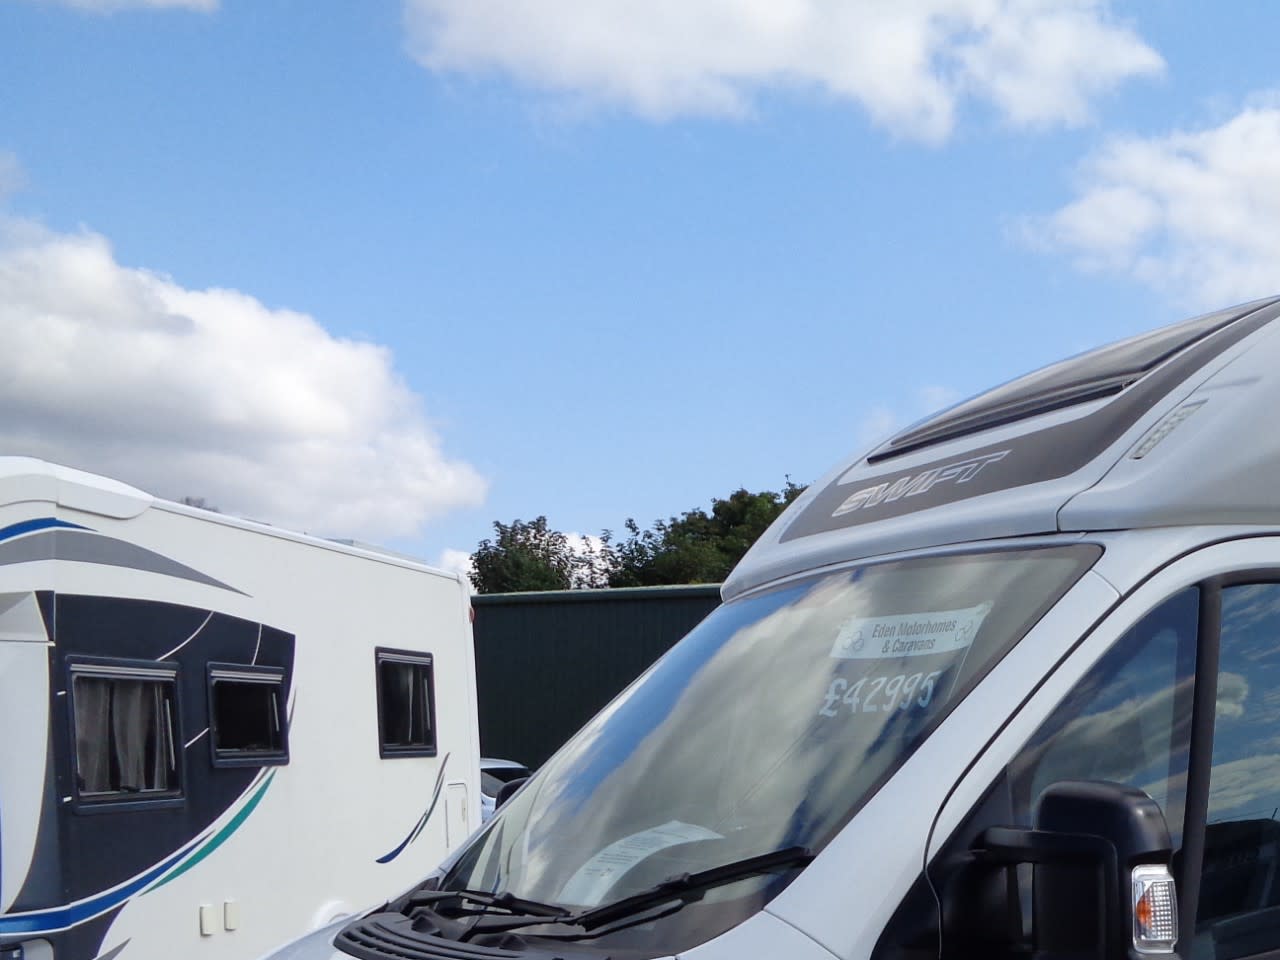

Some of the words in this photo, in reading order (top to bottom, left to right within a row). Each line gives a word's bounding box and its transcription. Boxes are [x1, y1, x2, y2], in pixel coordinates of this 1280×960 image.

[831, 449, 1013, 518] SWIFT
[872, 623, 896, 639] Eden
[896, 619, 958, 638] Motorhomes
[881, 641, 889, 654] &
[892, 638, 936, 654] Caravans
[818, 670, 943, 718] £42995
